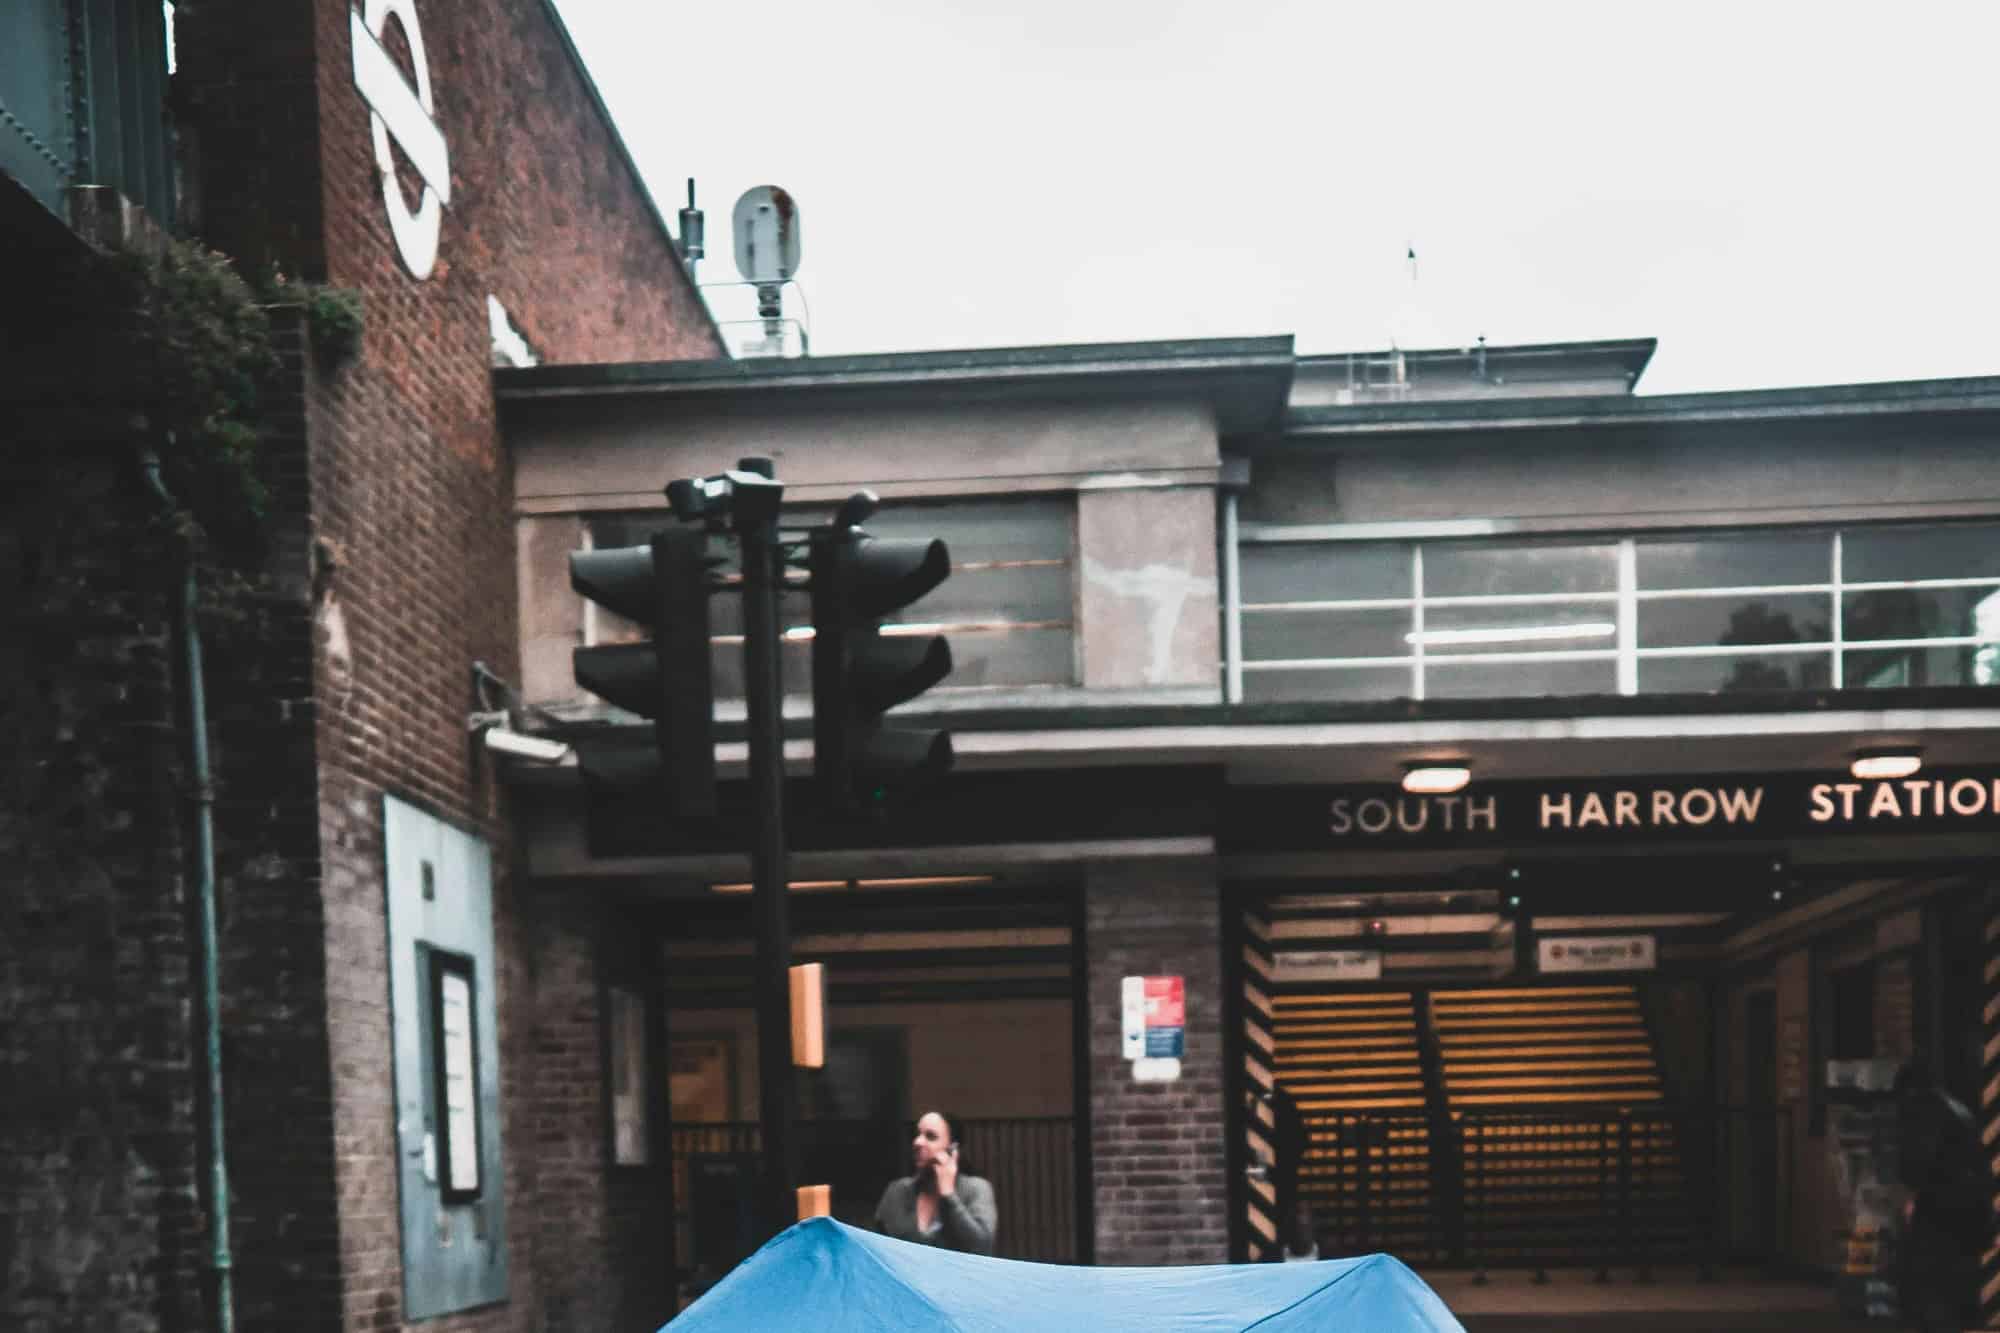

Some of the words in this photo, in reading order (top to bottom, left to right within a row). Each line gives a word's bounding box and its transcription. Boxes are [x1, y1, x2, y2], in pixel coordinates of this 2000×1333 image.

[1331, 796, 1497, 833] SOUTH
[1540, 787, 1764, 828] HARROW
[1809, 778, 2000, 821] STATIO
